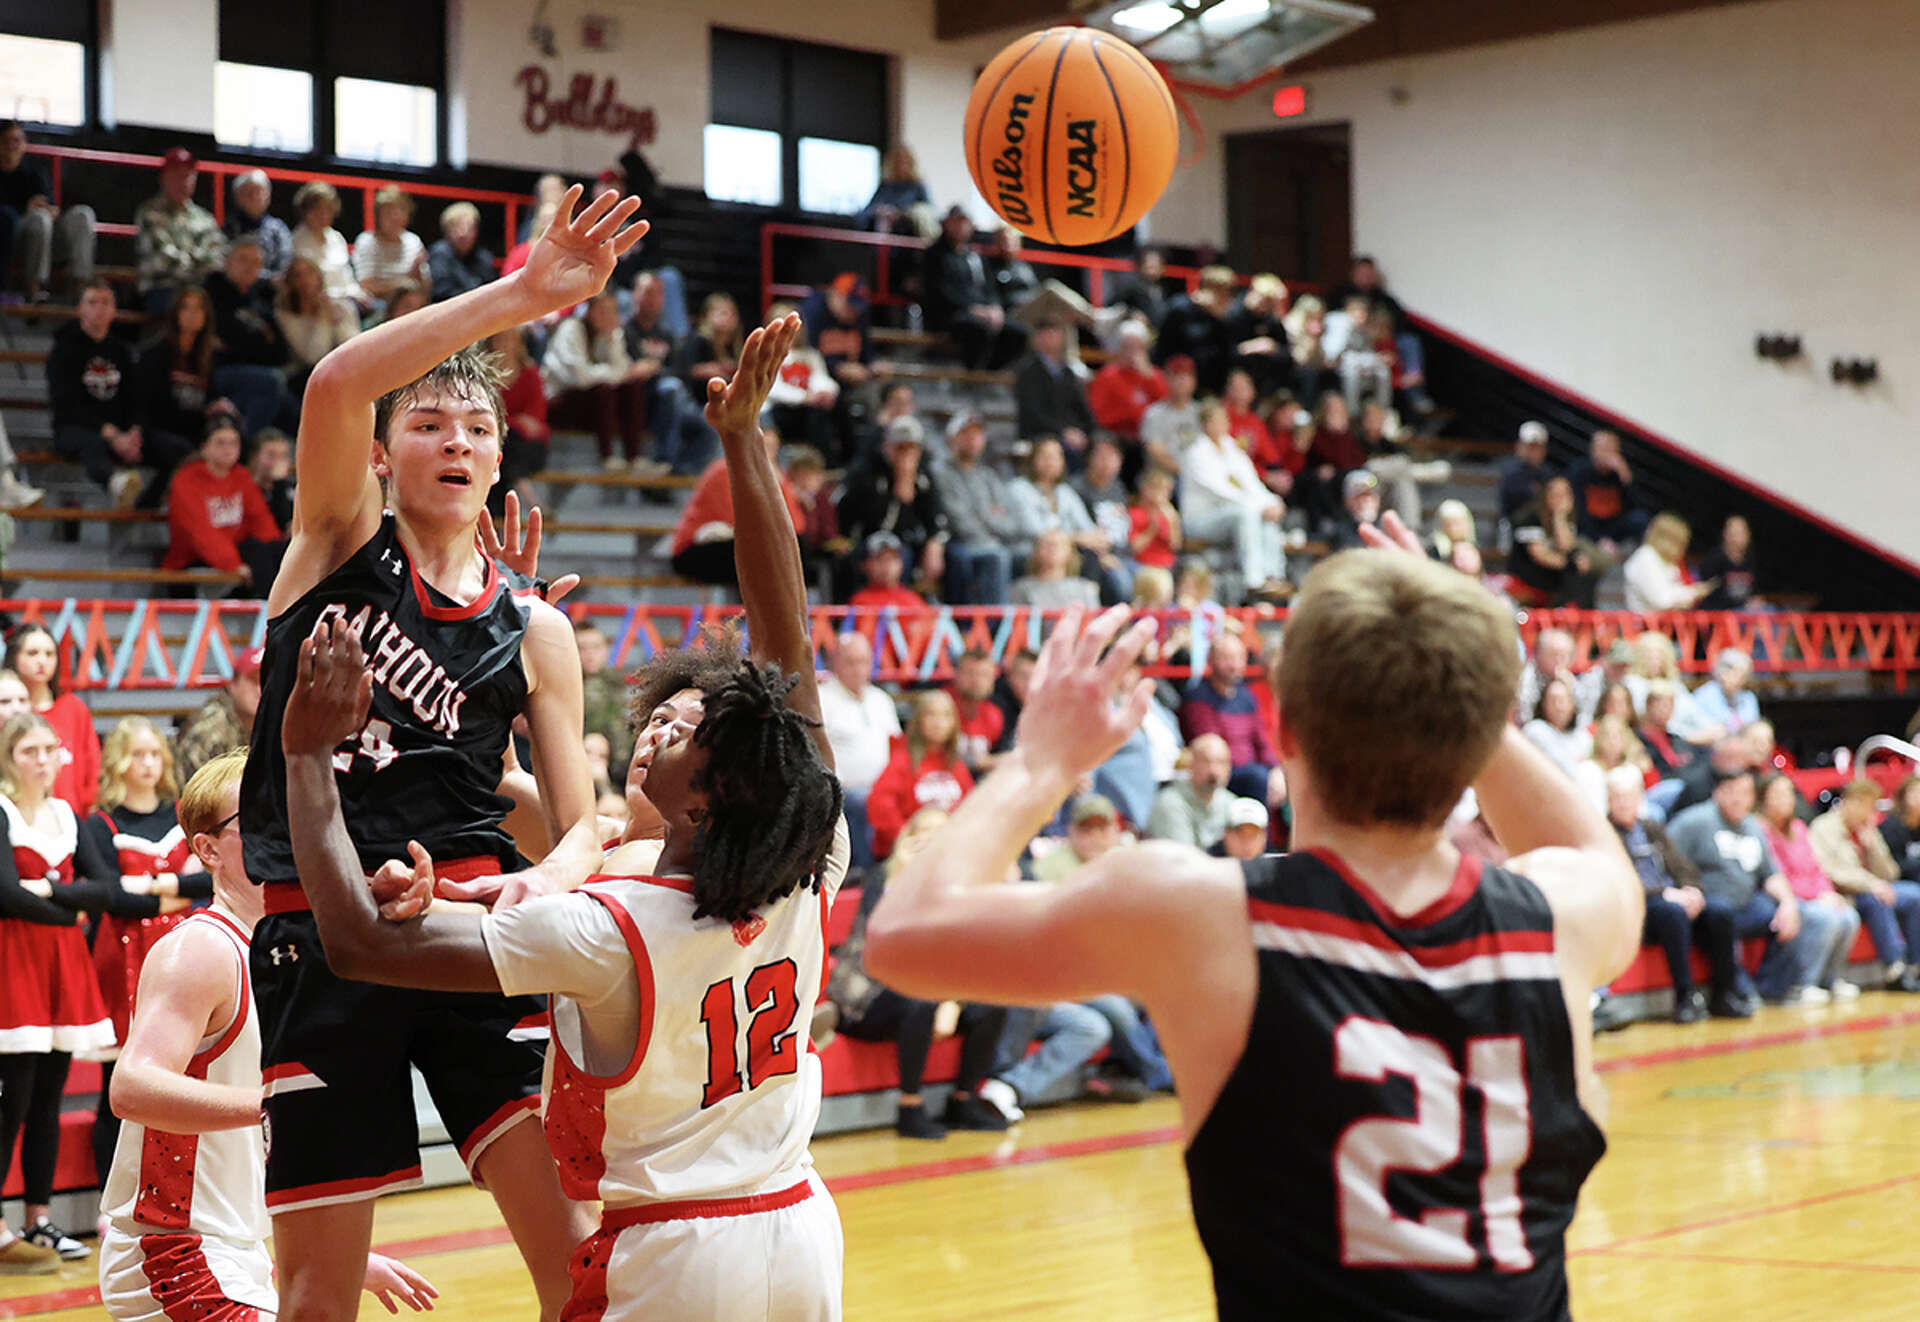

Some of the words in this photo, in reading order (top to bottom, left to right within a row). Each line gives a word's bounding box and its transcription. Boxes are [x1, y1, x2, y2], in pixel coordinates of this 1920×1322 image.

[992, 93, 1035, 226] Wilson
[1066, 119, 1098, 218] NCAA
[699, 957, 800, 1110] 12
[1332, 1013, 1536, 1274] 21
